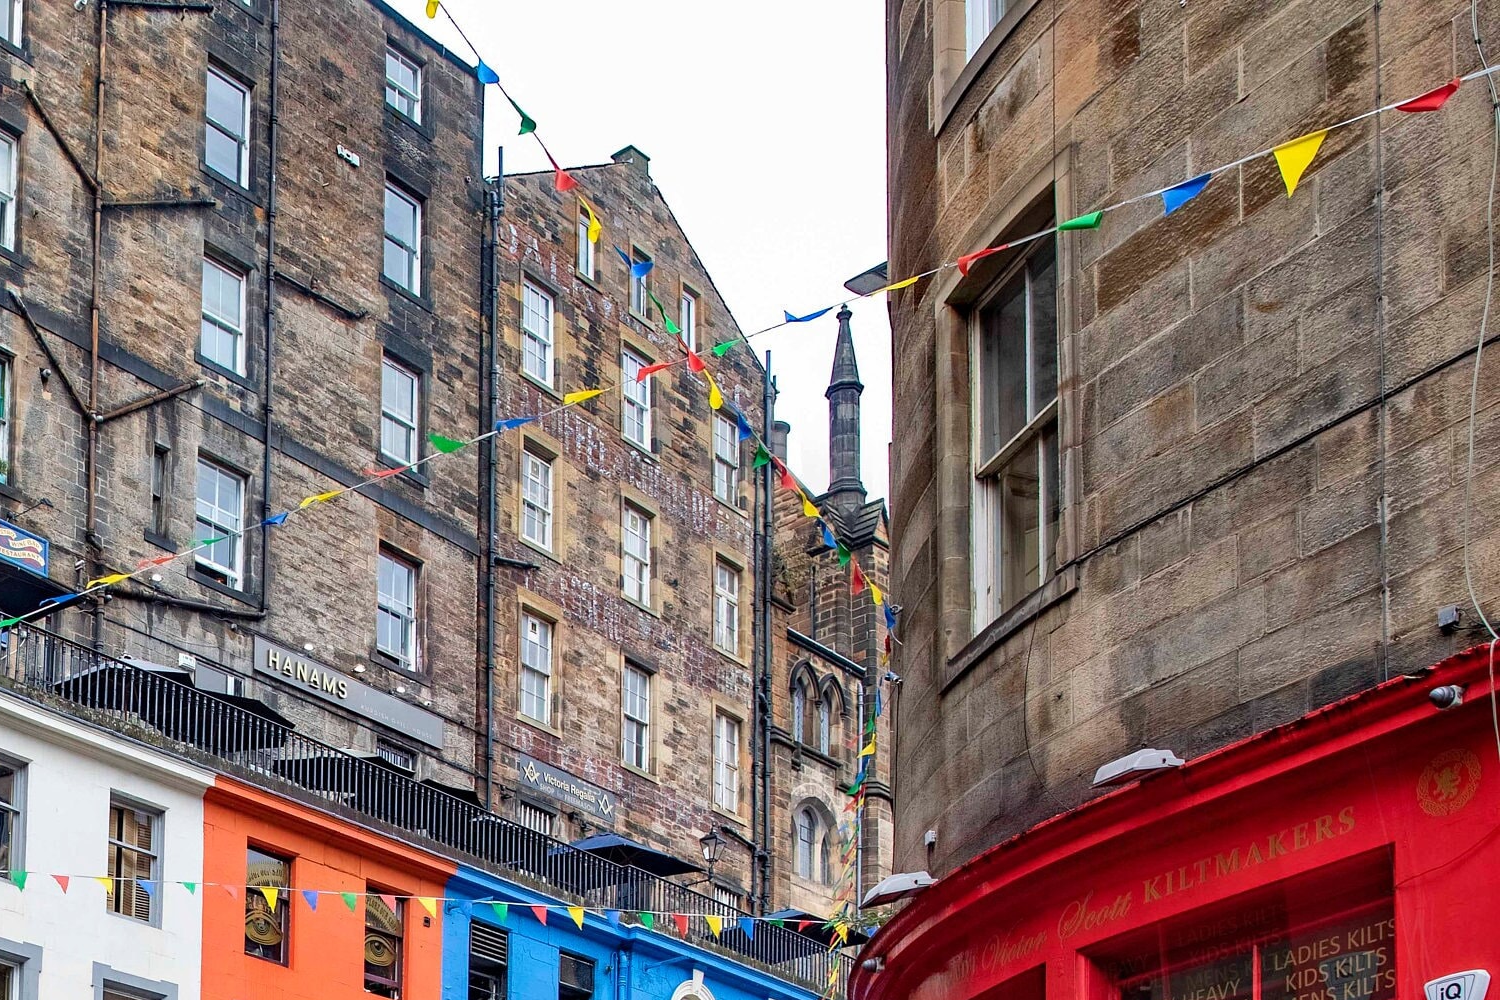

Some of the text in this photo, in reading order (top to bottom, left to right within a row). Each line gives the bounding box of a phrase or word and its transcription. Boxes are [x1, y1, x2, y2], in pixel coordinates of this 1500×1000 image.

[267, 648, 348, 700] HANAMS
[542, 771, 596, 804] Victoria Regalia
[1057, 892, 1133, 941] Scott
[1142, 805, 1358, 904] KILTMAKERS
[1273, 935, 1341, 971] LADIES
[1347, 918, 1396, 949] KILTS
[1285, 963, 1329, 993] KIDS
[1335, 946, 1388, 977] KILTS
[1343, 969, 1396, 1000] KILTS
